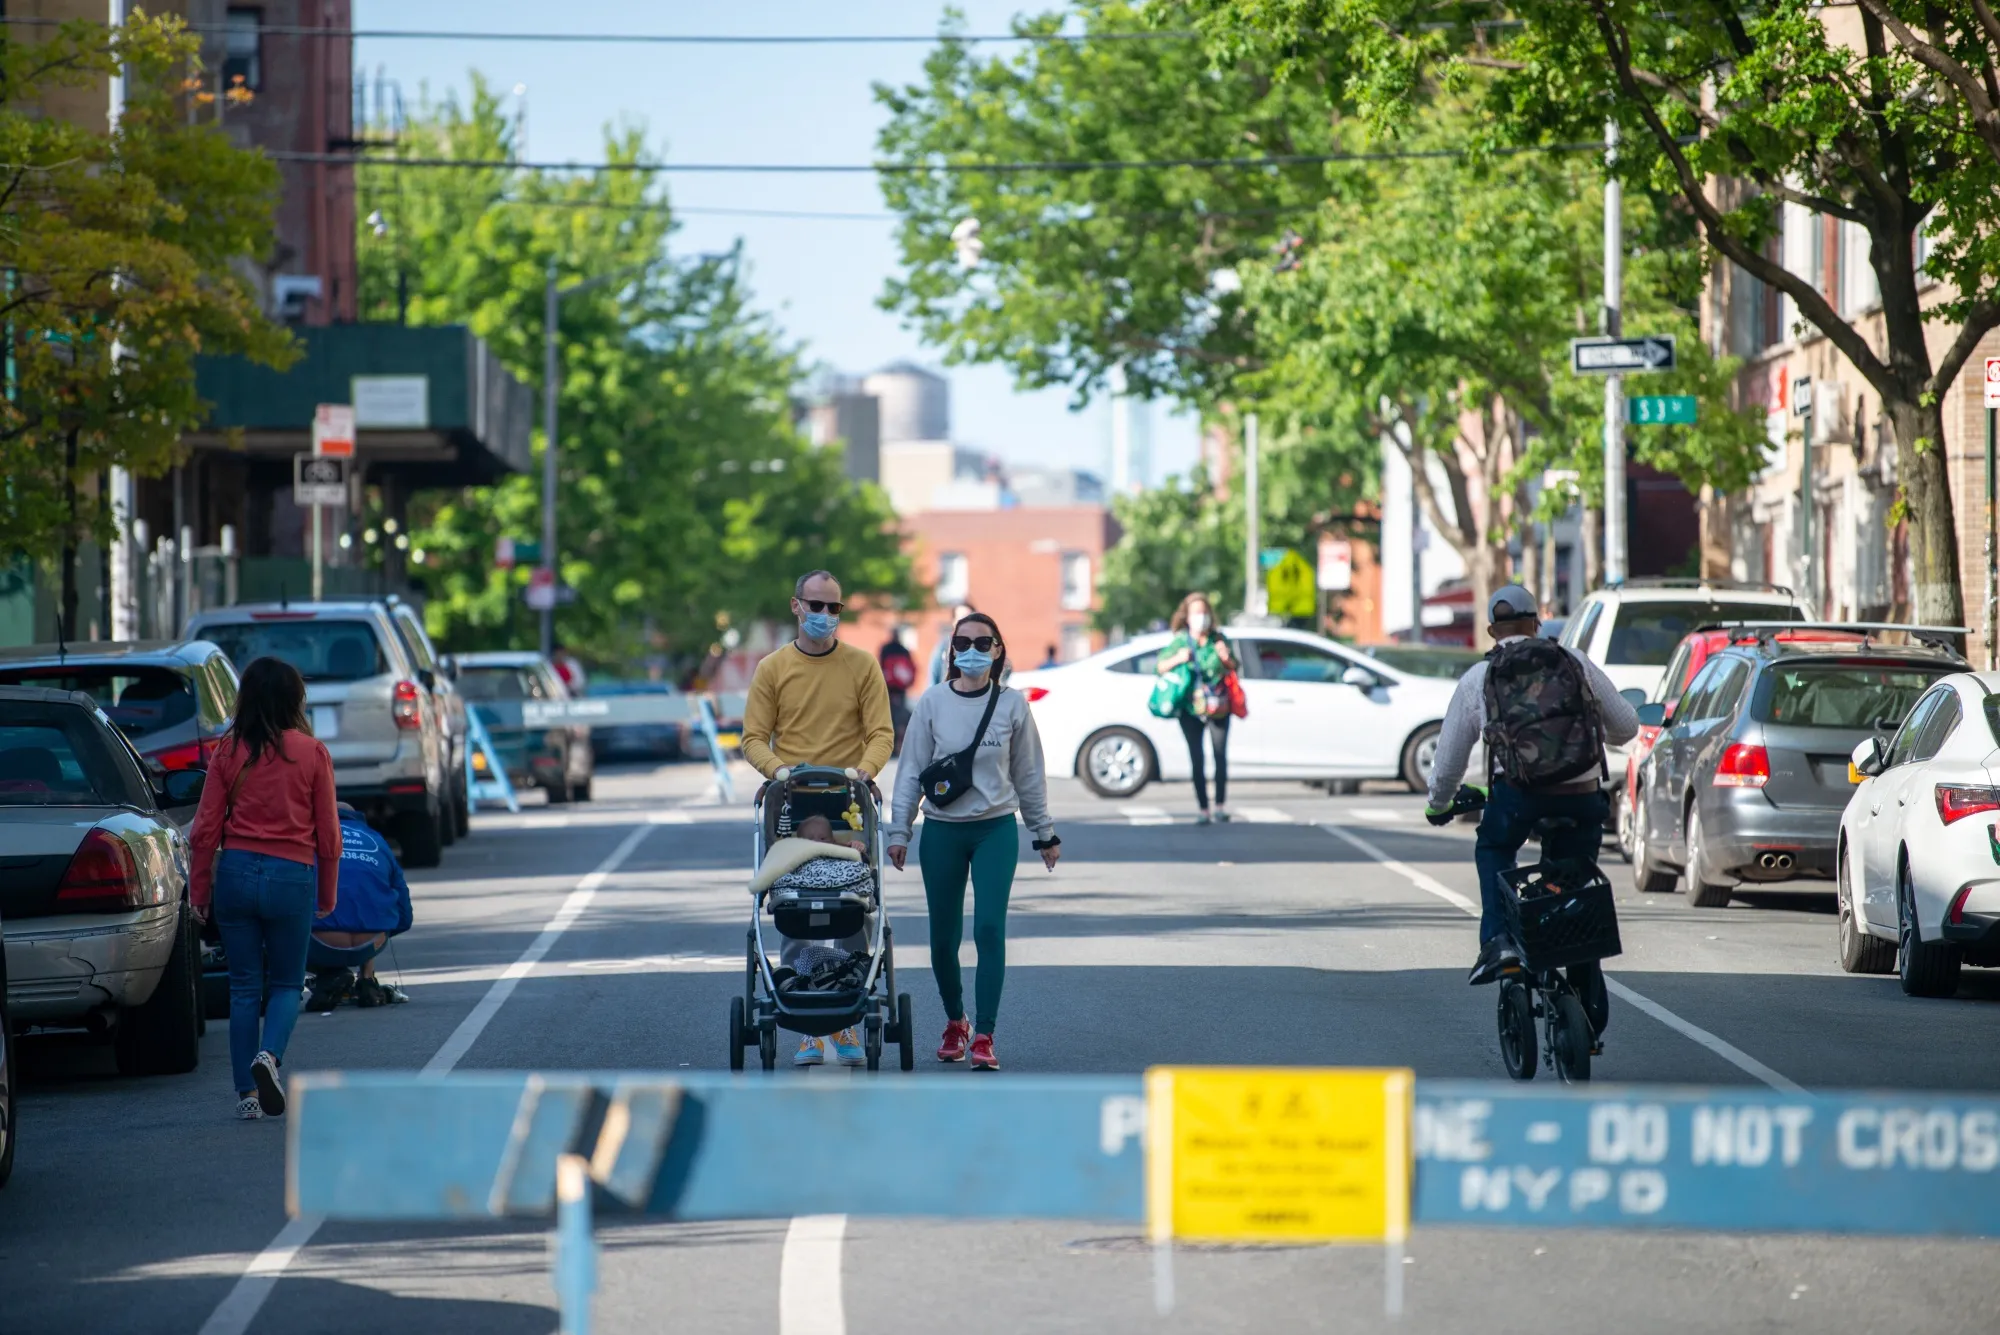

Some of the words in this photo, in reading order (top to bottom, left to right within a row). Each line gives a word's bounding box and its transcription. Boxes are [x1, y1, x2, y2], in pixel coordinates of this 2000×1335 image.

[1639, 399, 1650, 421] S
[1412, 1101, 1492, 1161] NE
[1588, 1102, 1668, 1165] DO
[1691, 1106, 1813, 1168] NOT
[1836, 1107, 2000, 1172] CROS
[1460, 1166, 1668, 1213] NYPD
